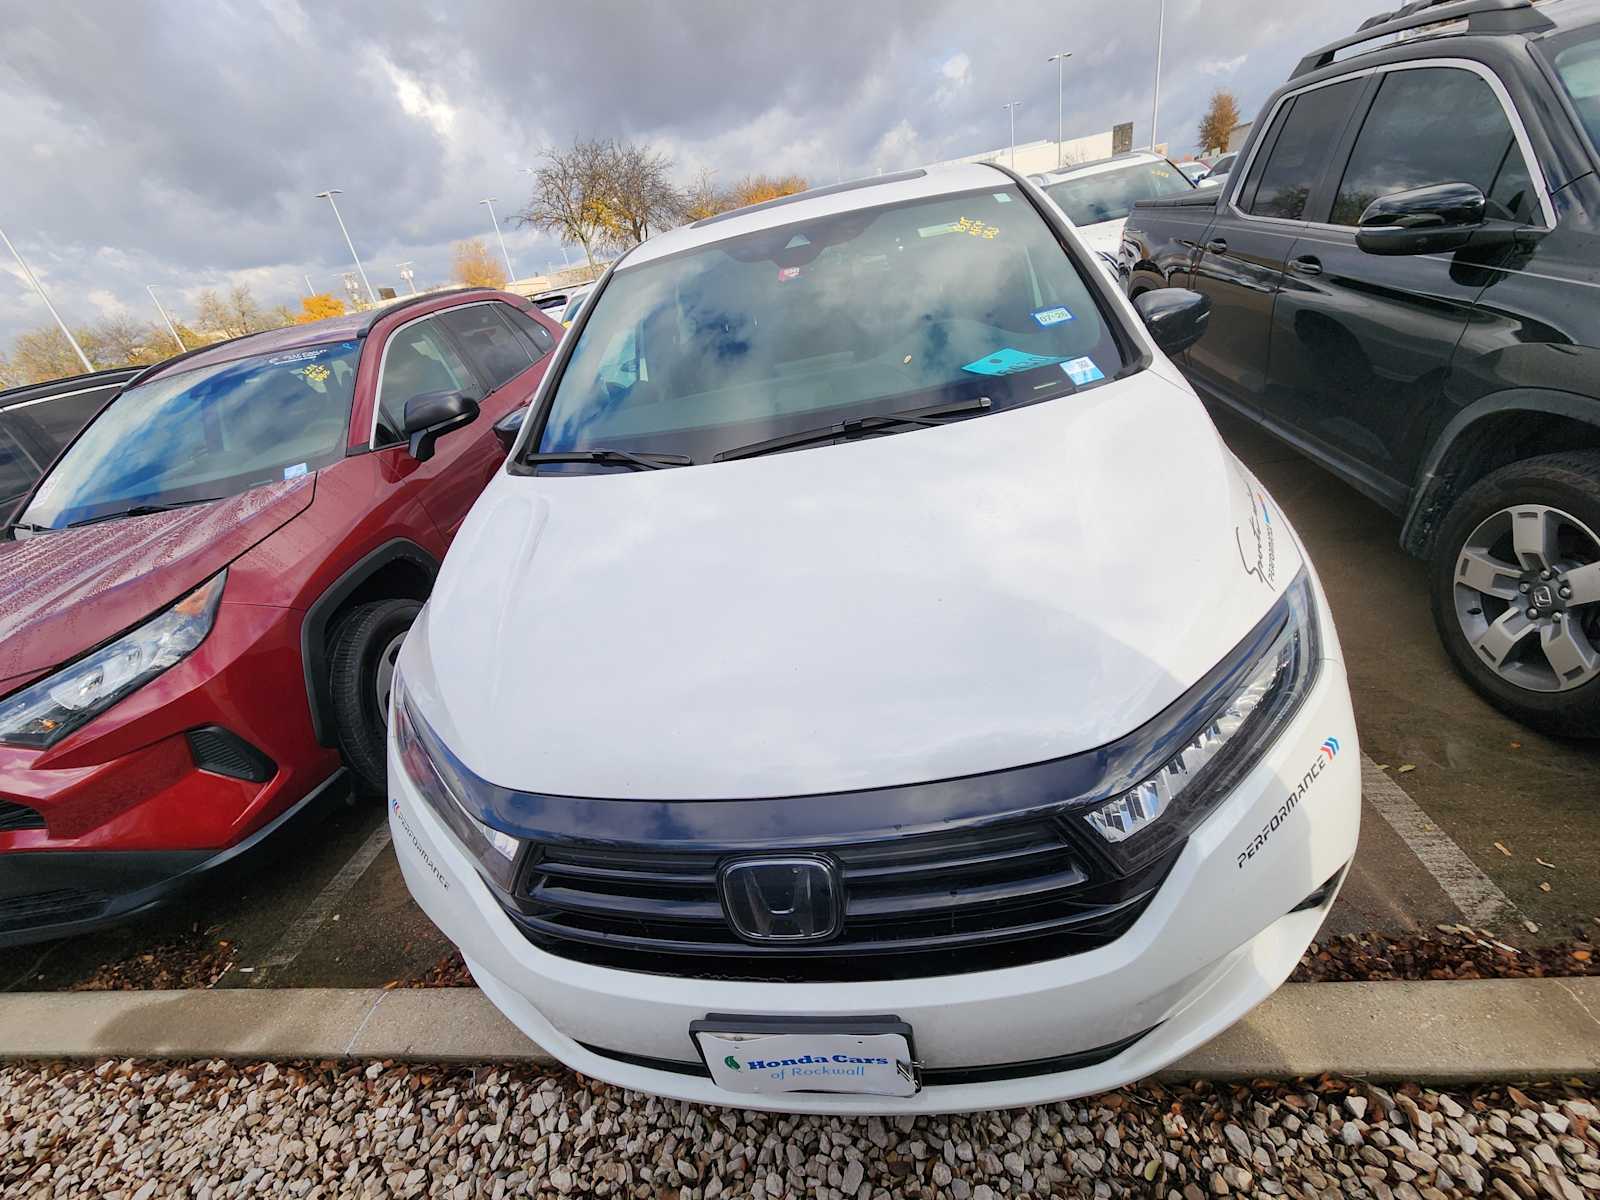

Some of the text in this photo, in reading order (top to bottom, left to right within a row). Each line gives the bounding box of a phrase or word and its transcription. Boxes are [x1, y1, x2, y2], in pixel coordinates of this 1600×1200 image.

[1237, 755, 1326, 869] PERFORMANCE
[748, 1054, 889, 1070] Honda Cars
[770, 1066, 865, 1081] of Rockwall
